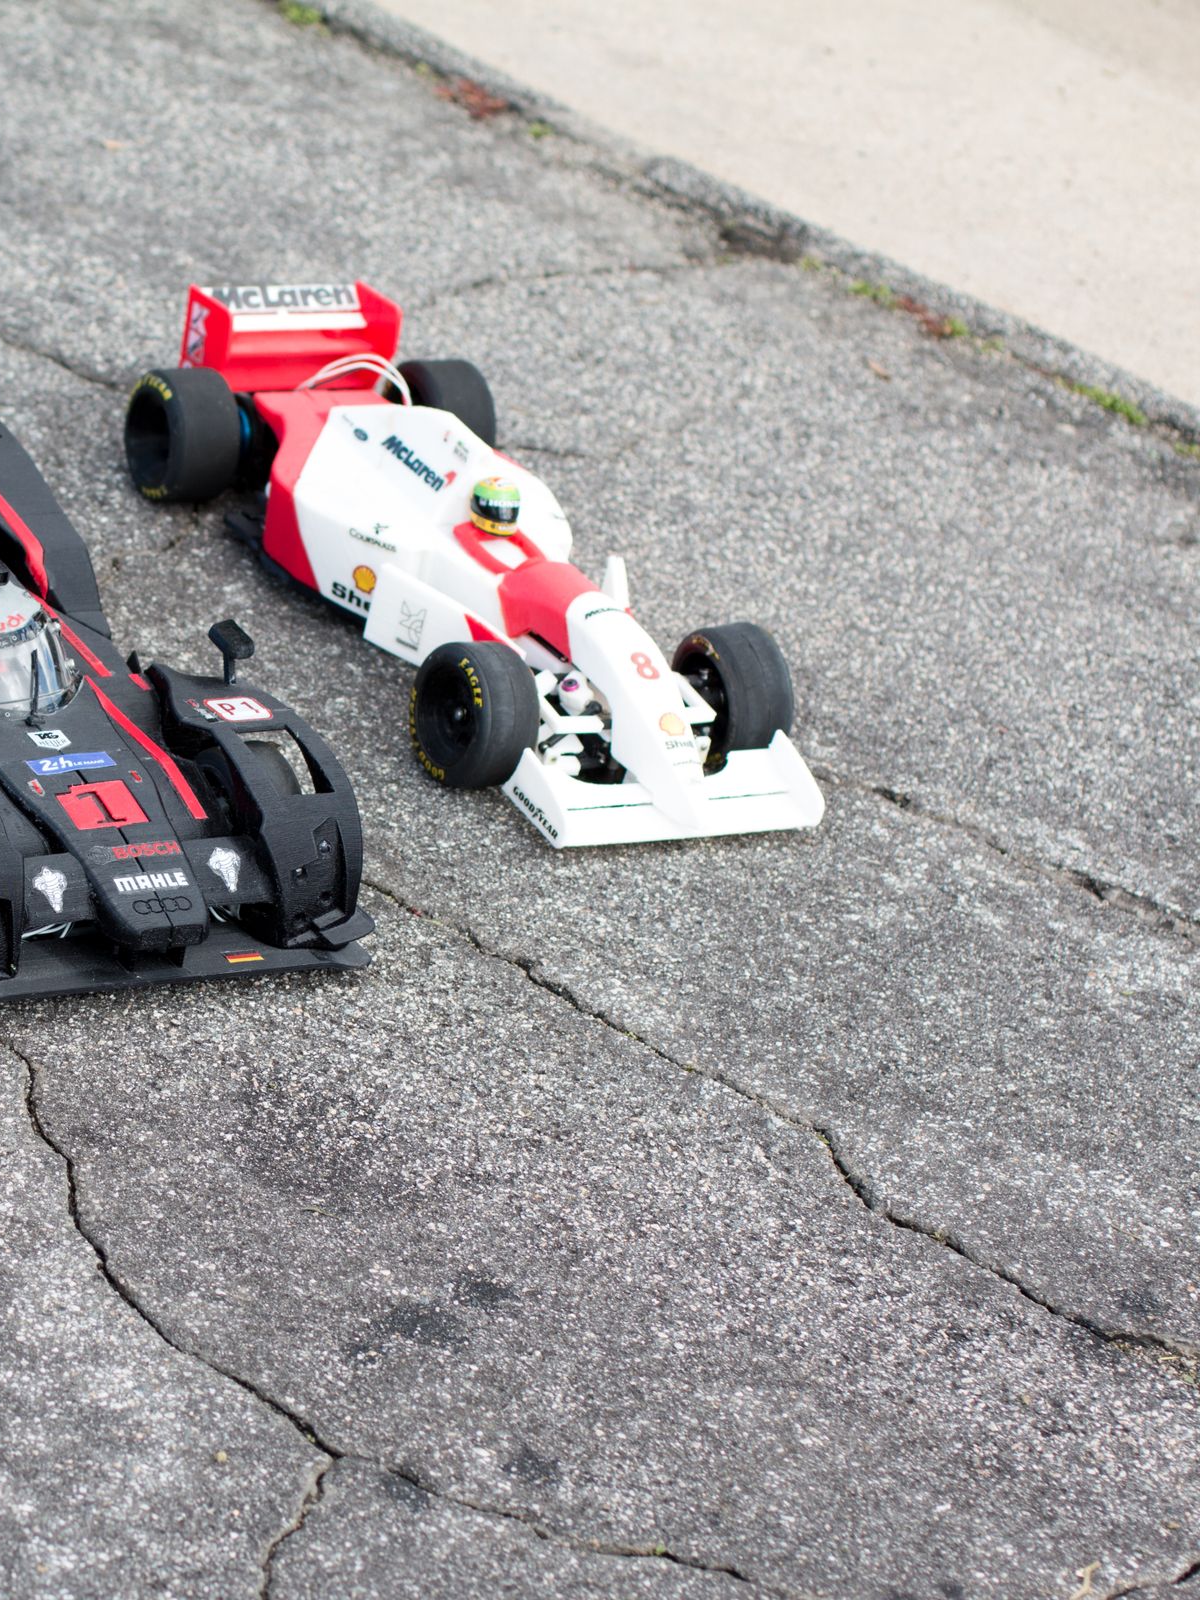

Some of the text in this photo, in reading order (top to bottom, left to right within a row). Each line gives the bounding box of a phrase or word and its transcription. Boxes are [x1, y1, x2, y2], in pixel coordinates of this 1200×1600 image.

[211, 286, 357, 309] McLaren
[382, 434, 445, 493] McLaren
[630, 652, 660, 681] 8
[458, 657, 484, 709] EAGLE
[34, 731, 60, 740] TAG
[38, 739, 67, 748] HEUER
[76, 791, 128, 824] 1
[512, 786, 559, 839] GOODYEAR
[112, 840, 182, 860] BOSCH
[113, 871, 190, 892] MAHLE
